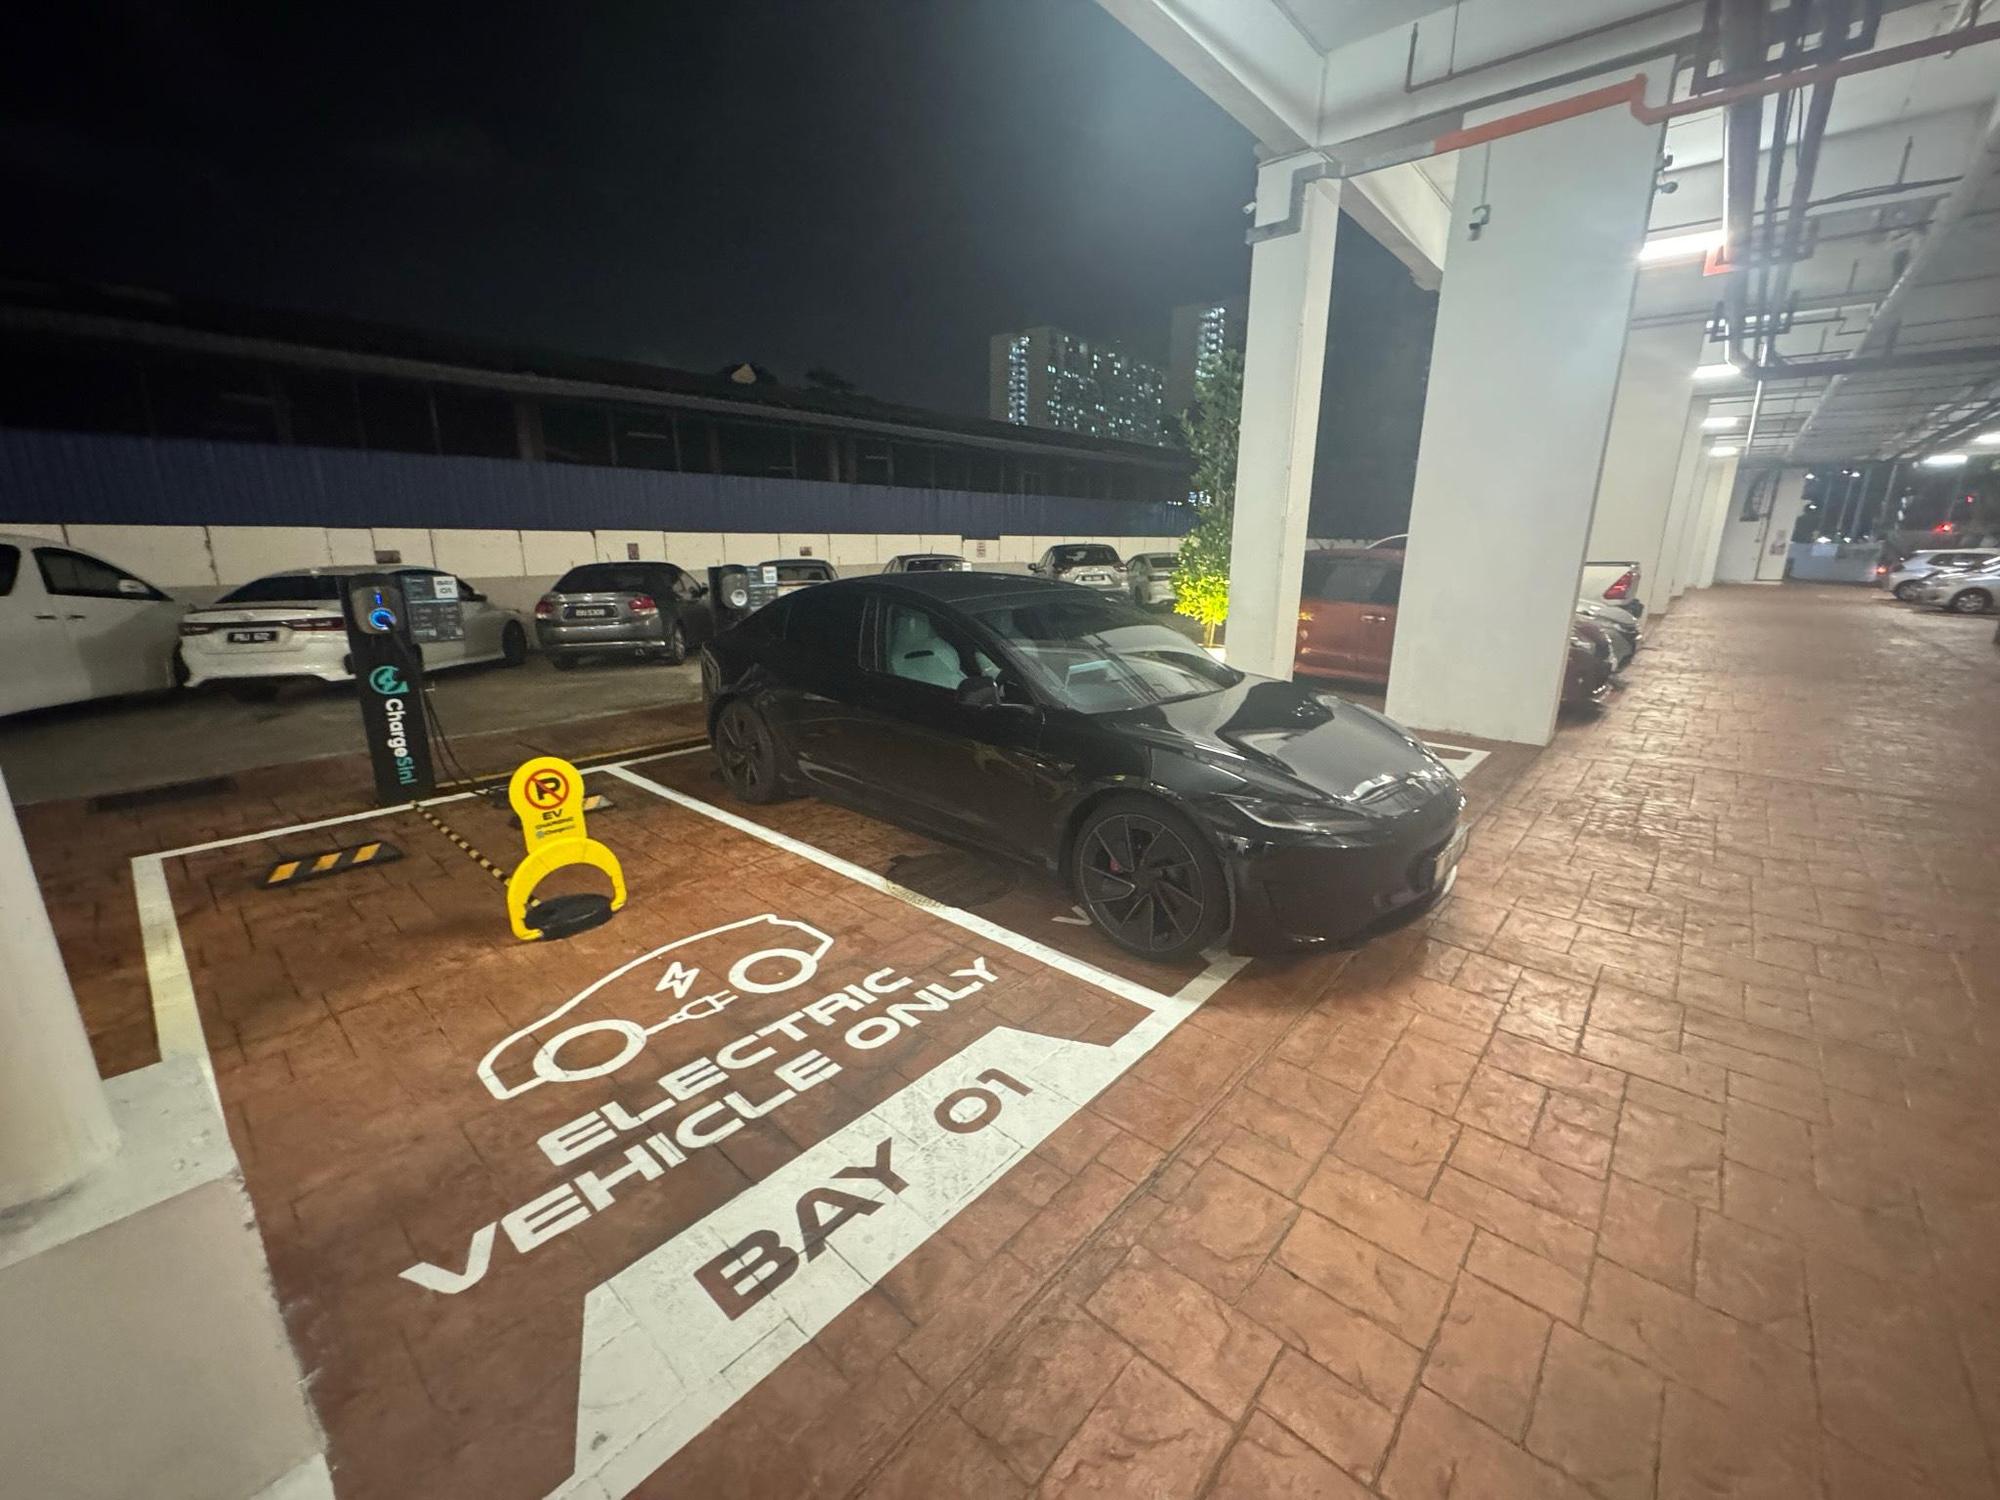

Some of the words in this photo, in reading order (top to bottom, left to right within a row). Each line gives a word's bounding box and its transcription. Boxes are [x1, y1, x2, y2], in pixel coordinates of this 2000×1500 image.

[385, 698, 418, 784] ChargeSini
[542, 809, 563, 821] EV
[398, 1050, 843, 1294] VEHICLE
[844, 956, 1000, 1050] ONLY
[537, 967, 914, 1167] ELECTRIC
[693, 1138, 910, 1321] BAY
[933, 1068, 1035, 1134] 01
